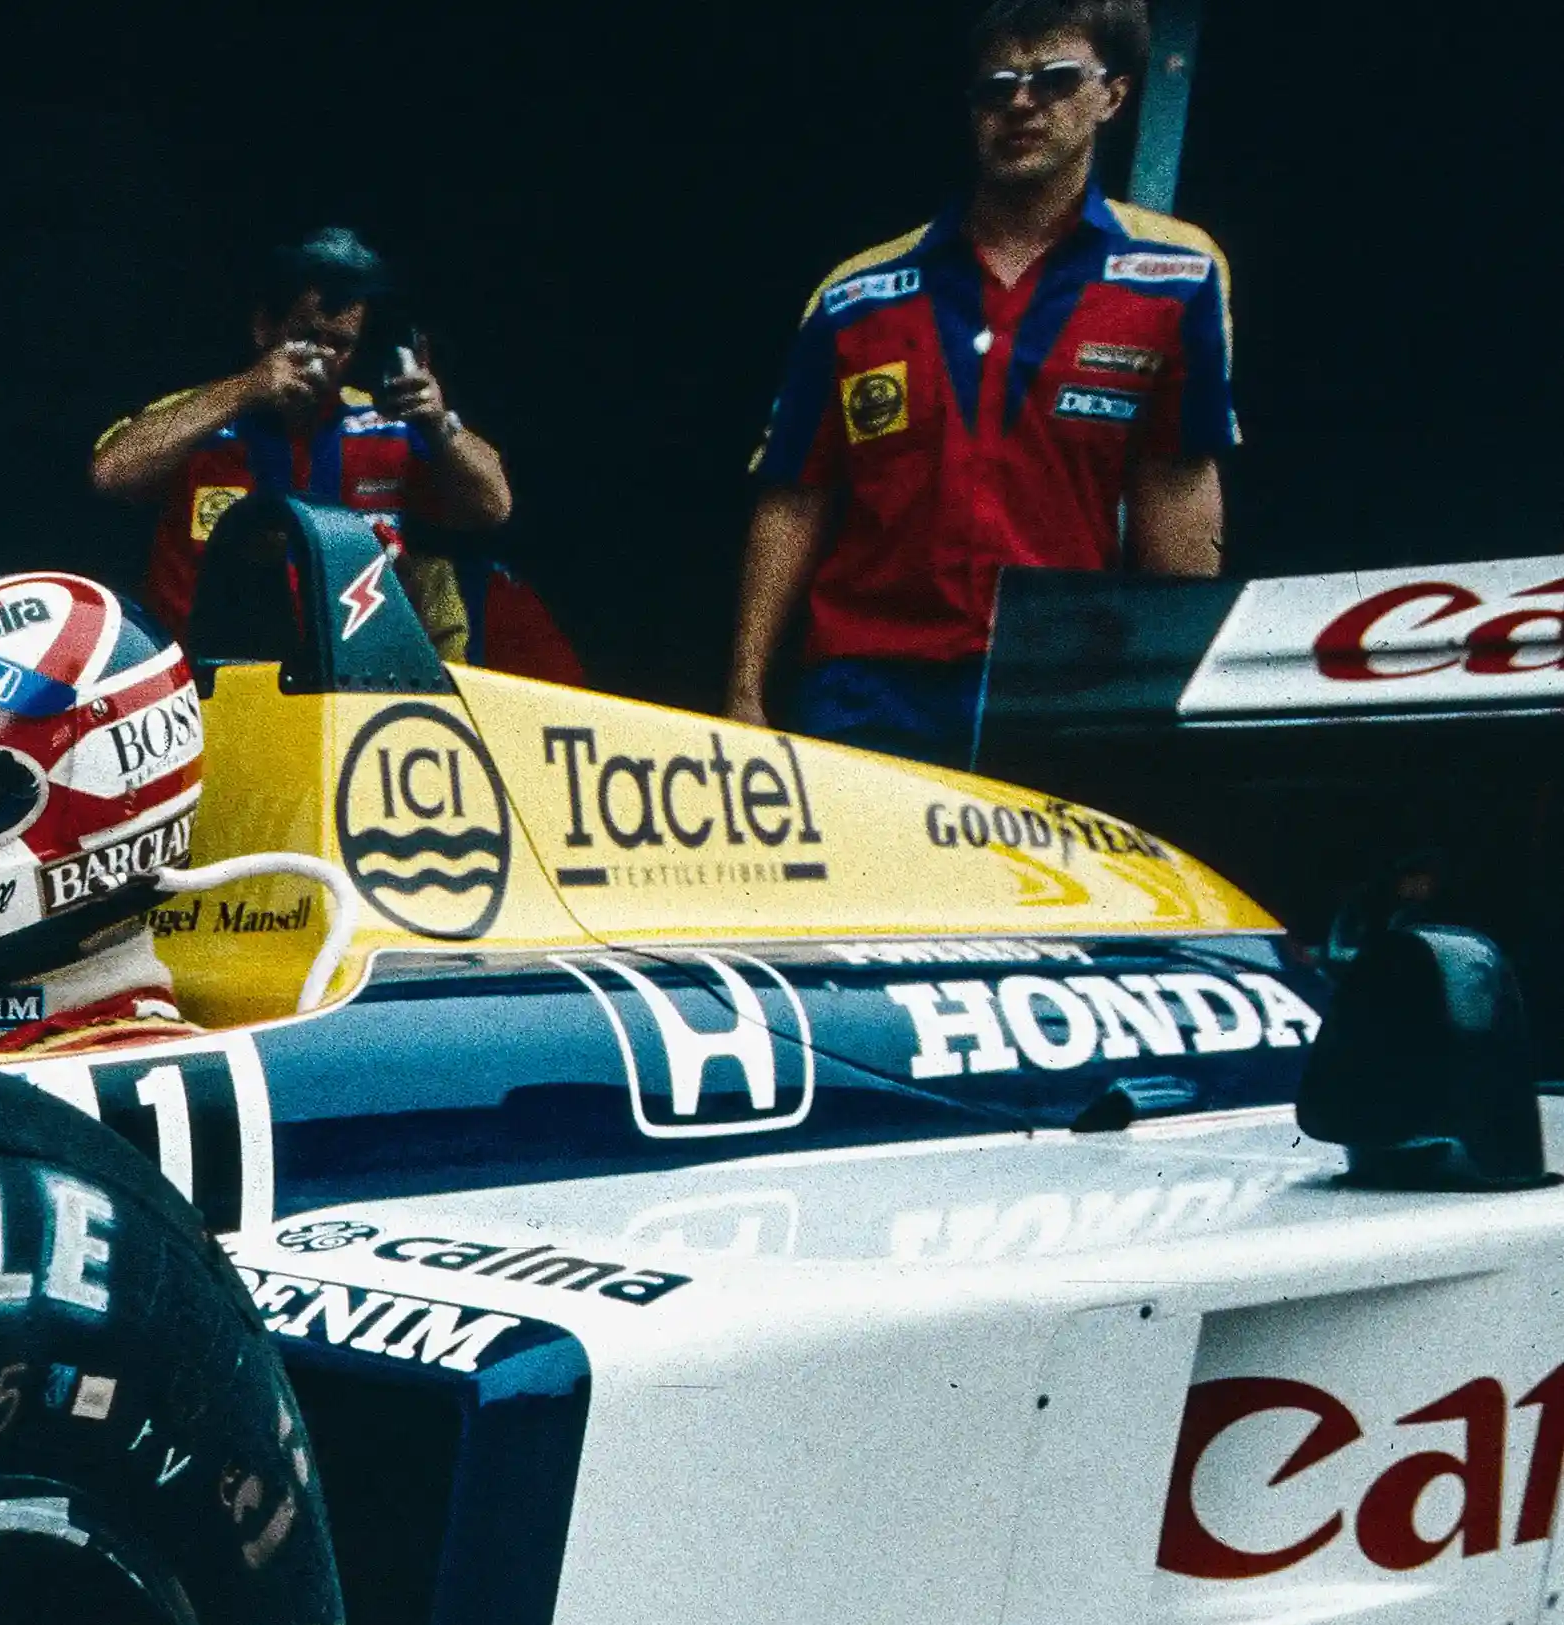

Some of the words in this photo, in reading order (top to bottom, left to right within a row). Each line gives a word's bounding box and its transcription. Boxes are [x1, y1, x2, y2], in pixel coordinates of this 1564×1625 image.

[378, 746, 466, 820] ICI
[542, 726, 824, 849] Tactel
[213, 894, 312, 934] Mansell
[885, 972, 1322, 1080] HONDA
[373, 1236, 697, 1307] calma
